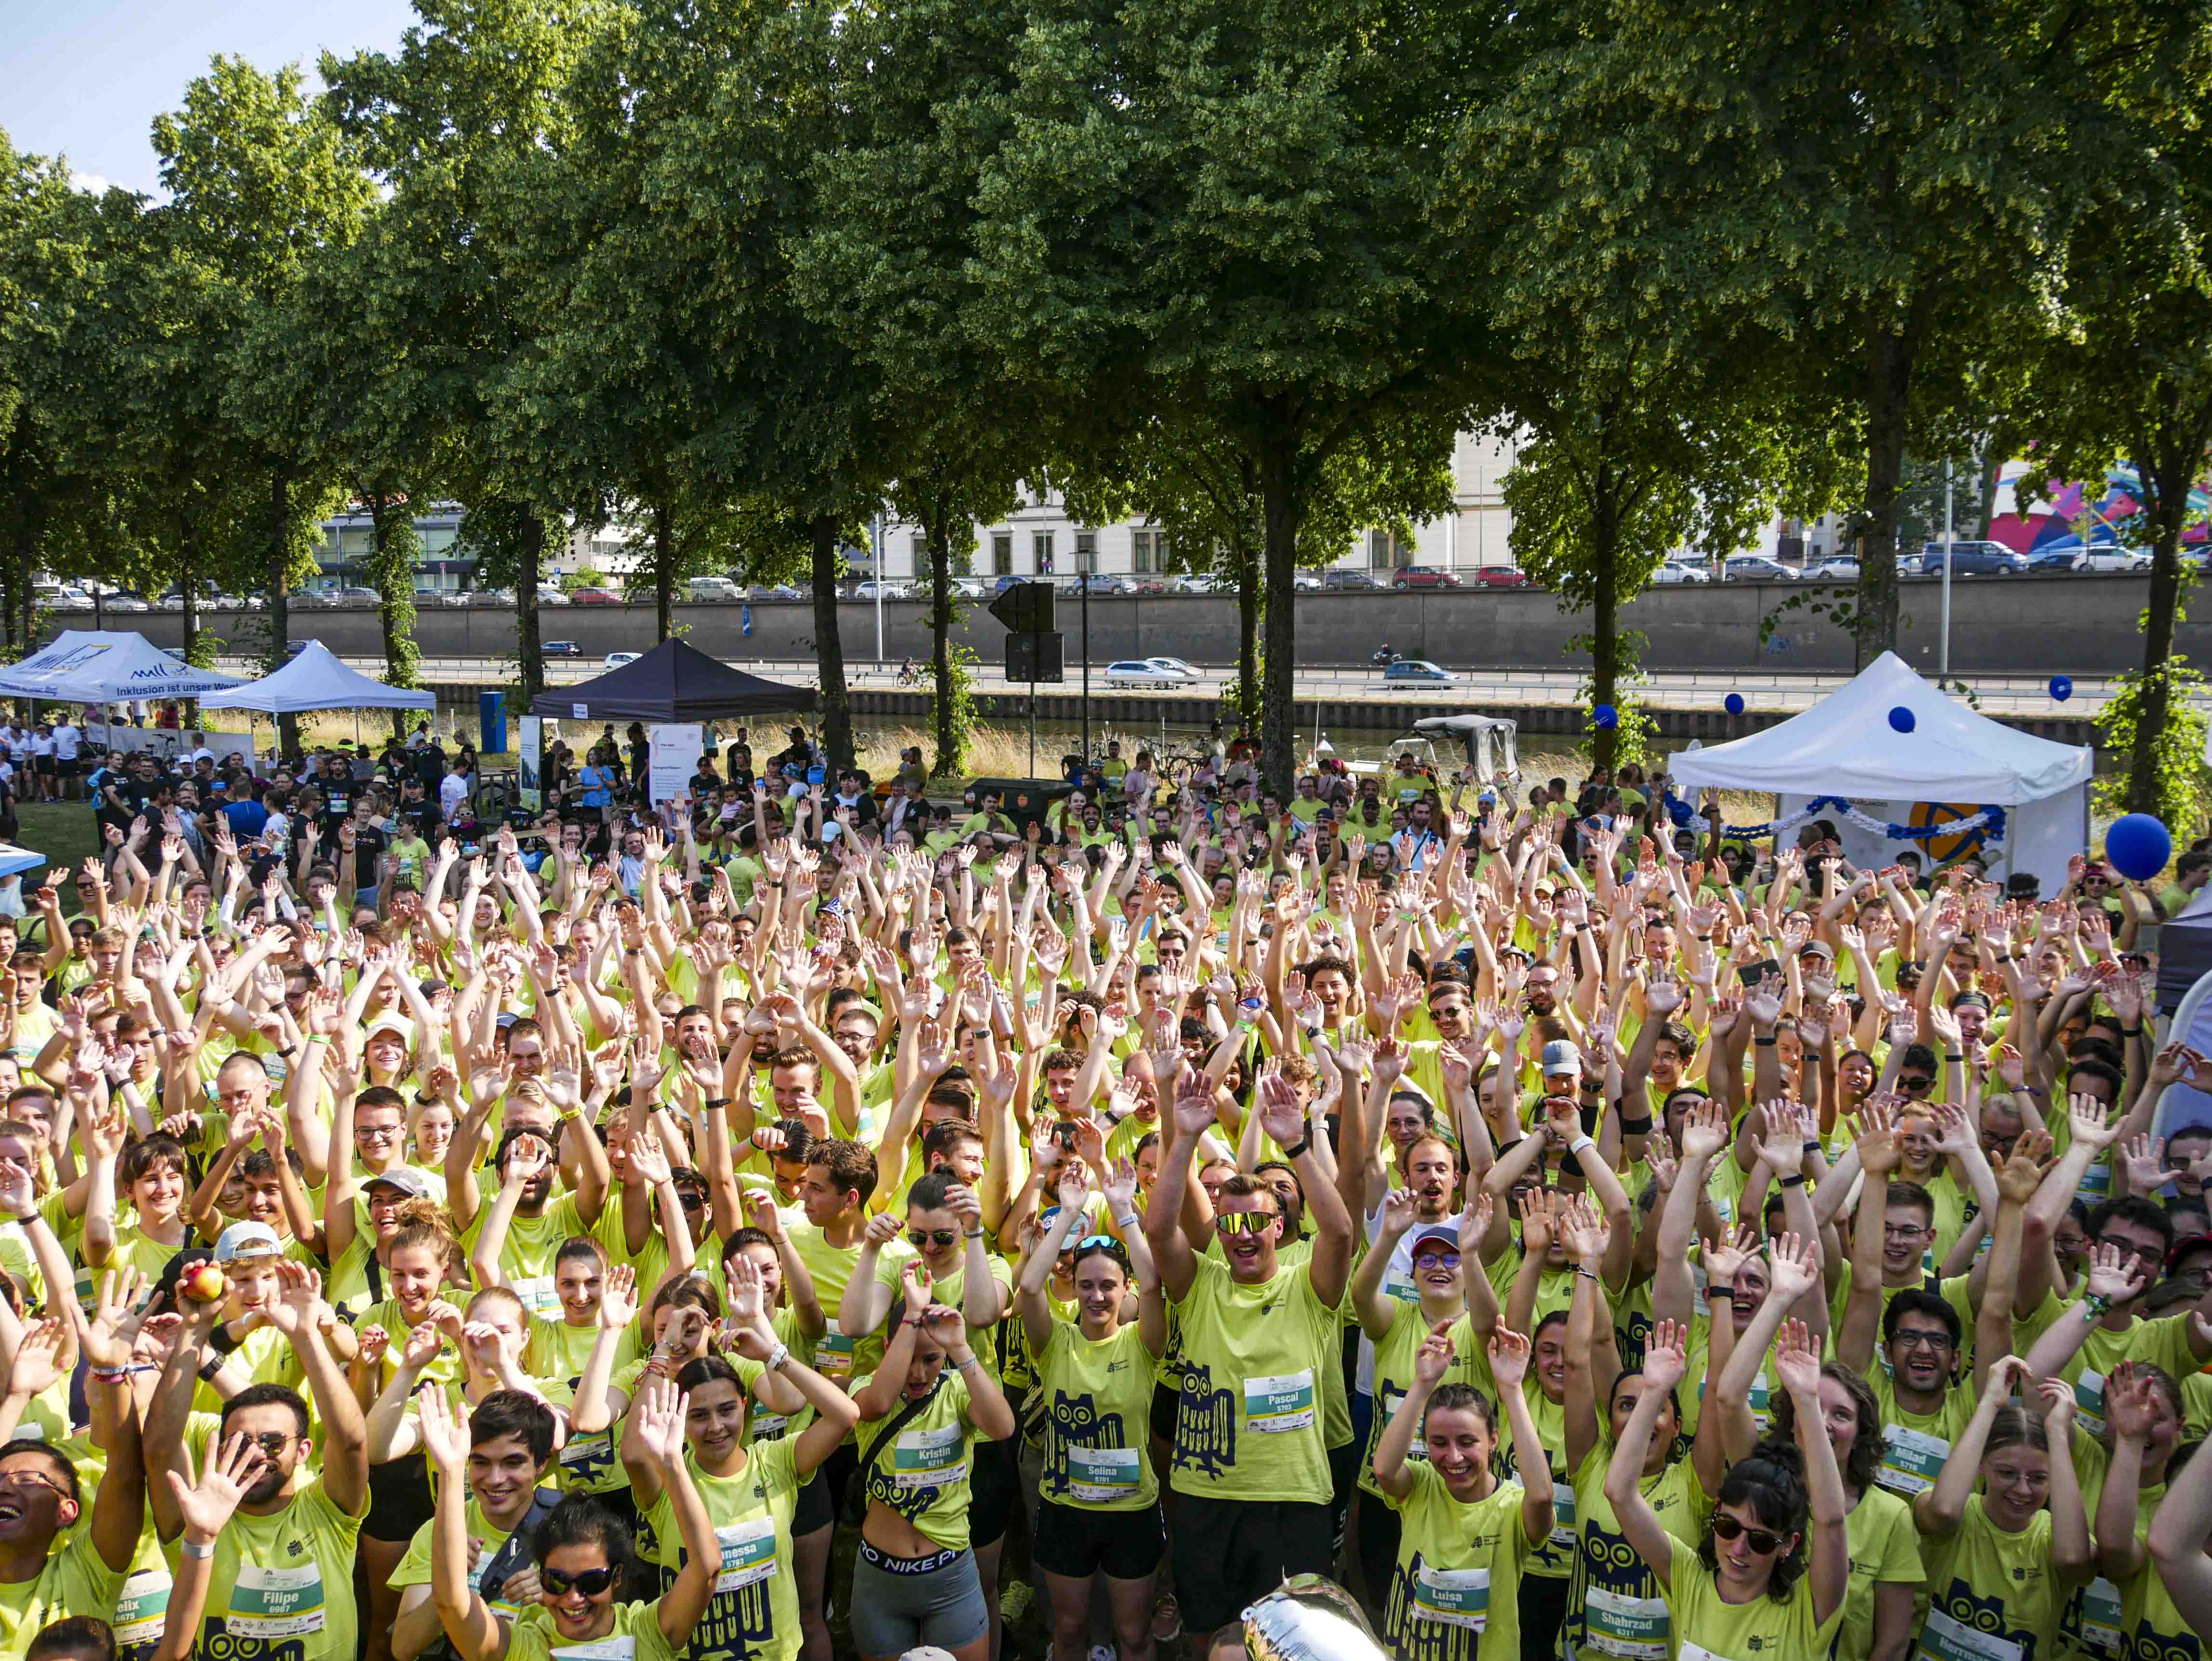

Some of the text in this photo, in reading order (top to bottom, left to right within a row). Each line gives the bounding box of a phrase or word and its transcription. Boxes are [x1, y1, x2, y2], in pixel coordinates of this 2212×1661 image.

[117, 685, 165, 697] Inklusion
[168, 684, 180, 693] ist
[183, 684, 212, 692] unser
[1268, 1392, 1299, 1405] Pascal
[919, 1447, 950, 1460] Kristin
[1088, 1465, 1117, 1476] Selina
[721, 1544, 756, 1560] nessa
[861, 1539, 879, 1562] RO
[884, 1557, 936, 1573] NIKE
[263, 1592, 299, 1605] Filipe
[1432, 1588, 1463, 1602] Luisa
[117, 1600, 140, 1612] elix
[1601, 1611, 1653, 1630] Shahrzad
